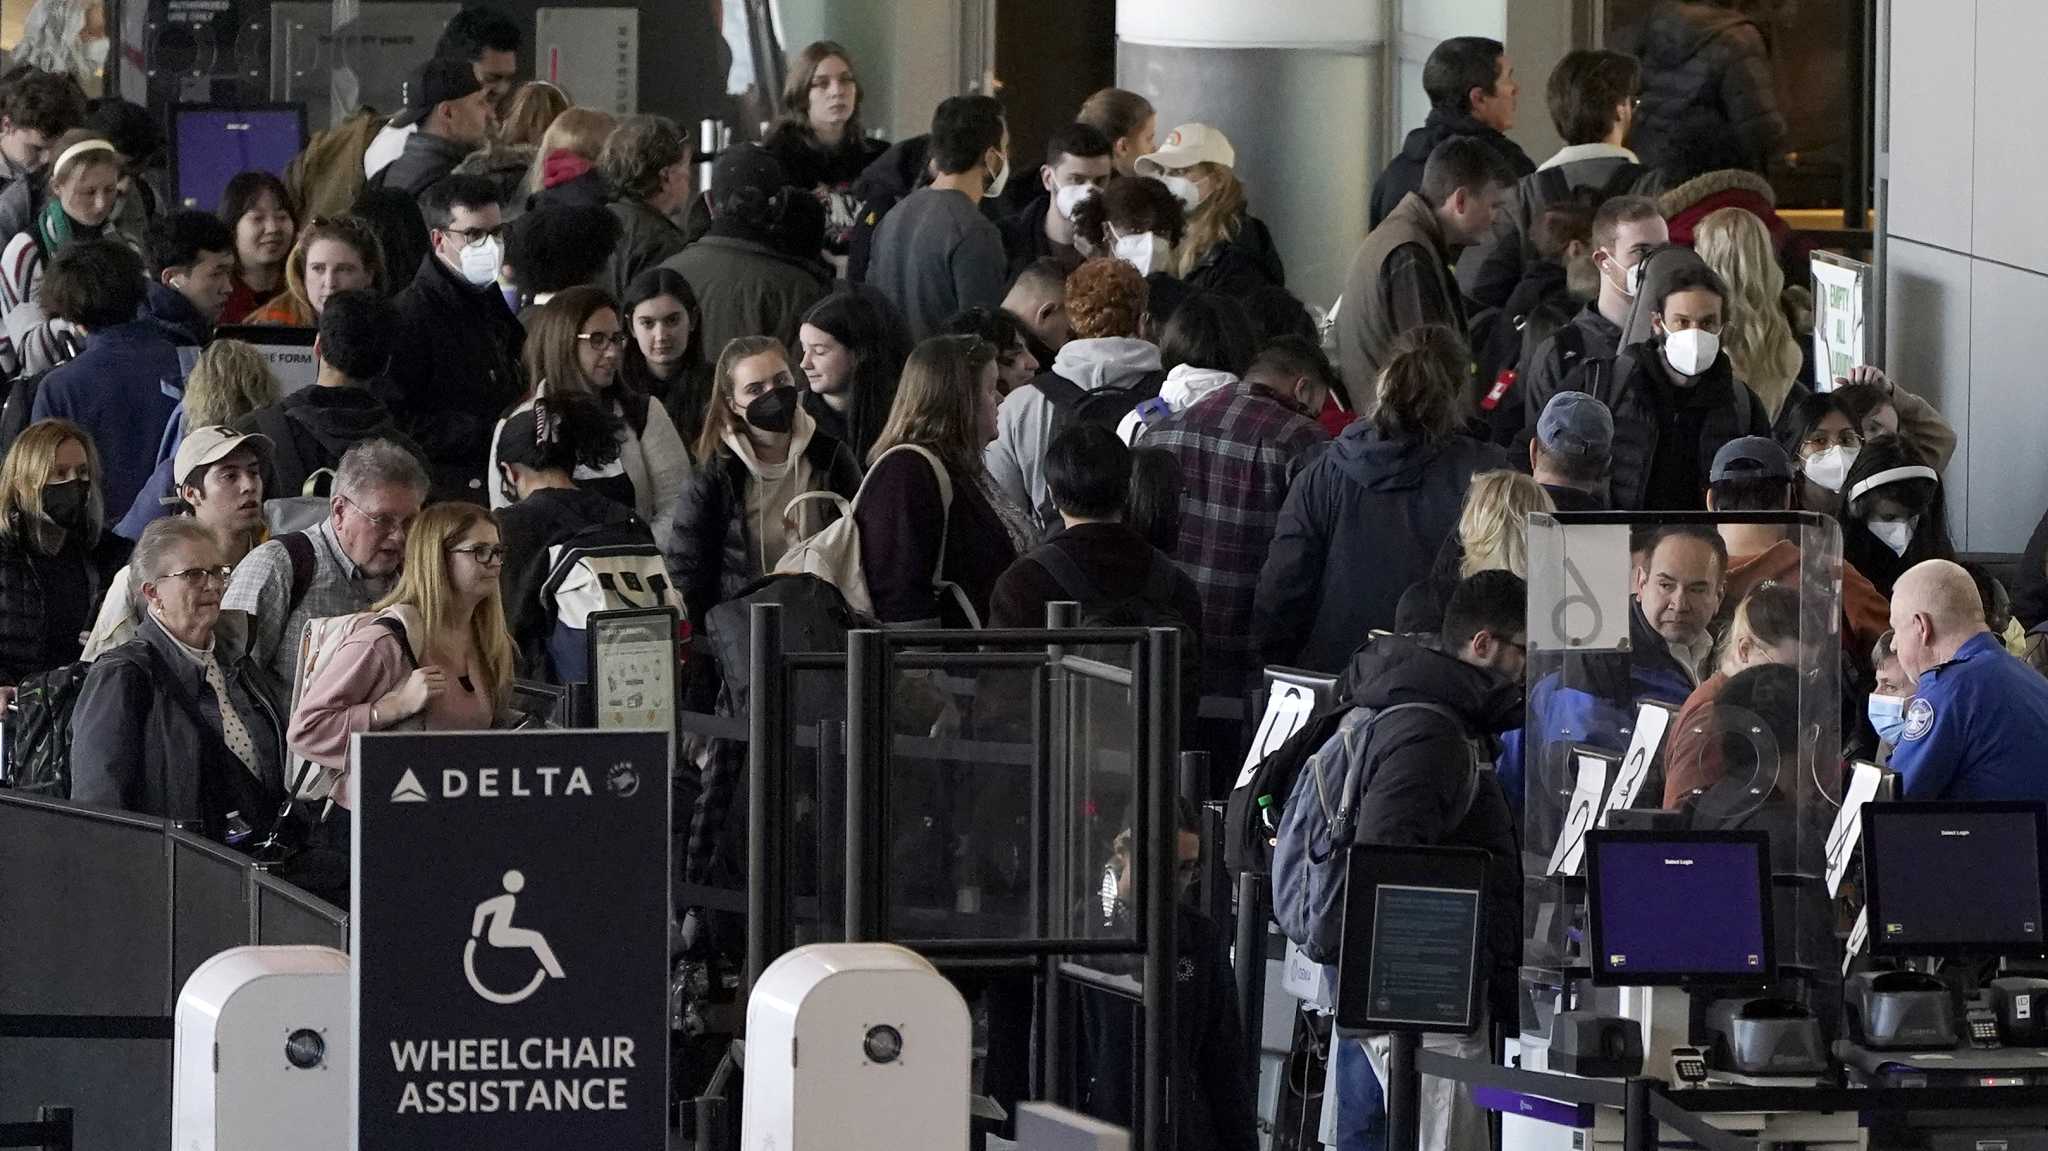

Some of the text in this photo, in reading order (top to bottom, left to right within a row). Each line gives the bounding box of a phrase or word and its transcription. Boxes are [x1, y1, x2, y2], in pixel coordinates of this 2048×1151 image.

[278, 353, 312, 363] FORM
[442, 767, 593, 798] DELTA
[1664, 858, 1694, 867] Select Login
[390, 1036, 636, 1072] WHEELCHAIR
[397, 1078, 628, 1114] ASSISTANCE
